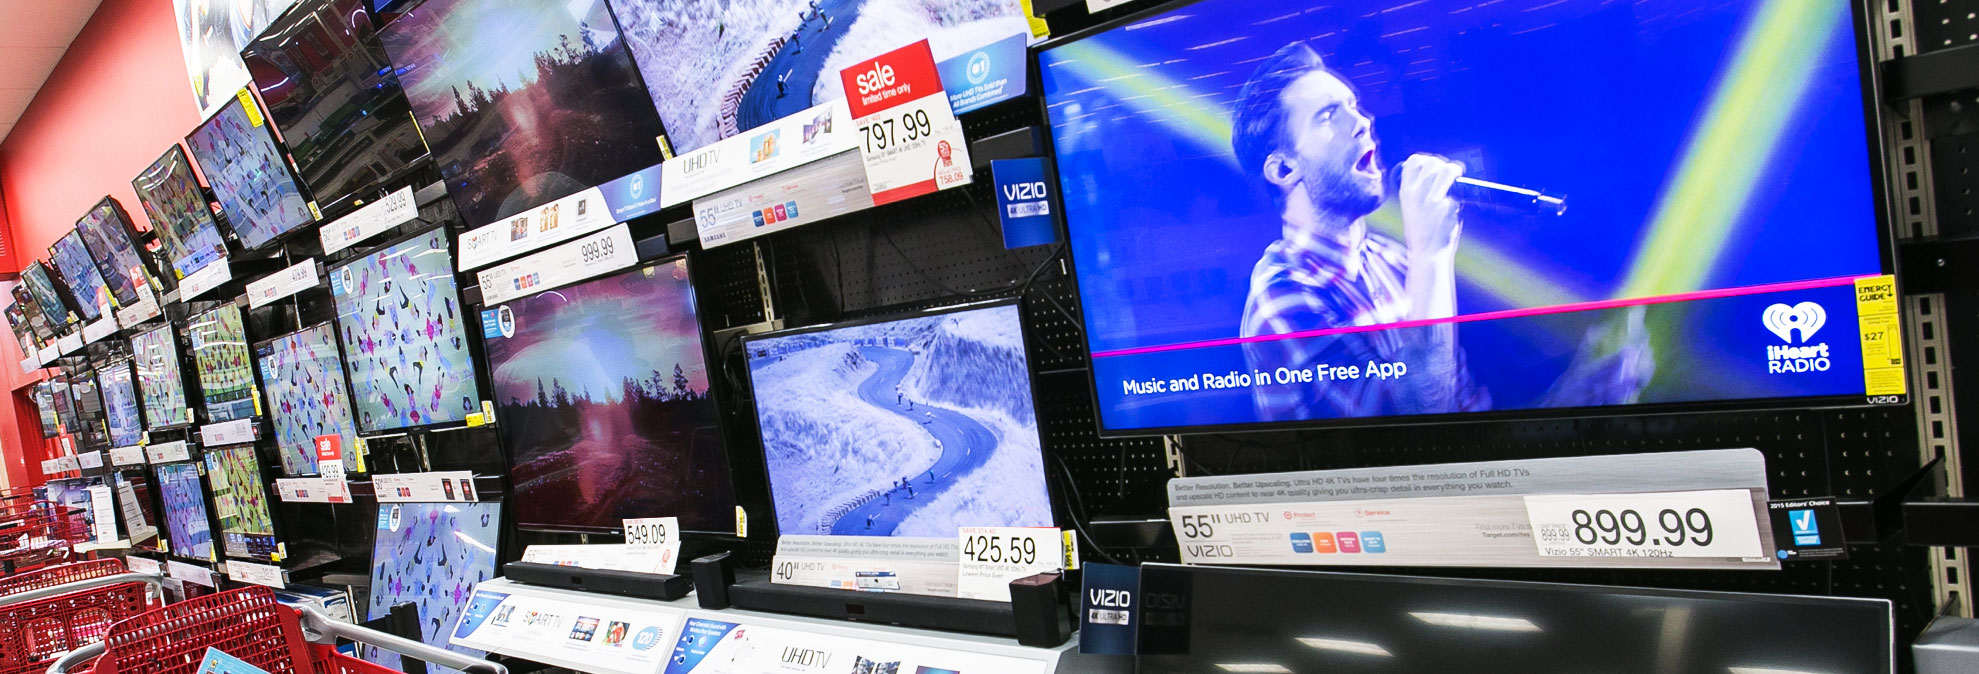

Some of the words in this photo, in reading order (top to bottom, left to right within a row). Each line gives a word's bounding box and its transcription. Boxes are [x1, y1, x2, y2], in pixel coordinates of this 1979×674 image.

[856, 61, 895, 94] sale
[862, 91, 882, 106] limited
[882, 88, 897, 99] time
[897, 82, 911, 94] only
[859, 109, 931, 153] 797.99
[683, 152, 707, 174] UHD
[708, 147, 721, 165] TV
[1004, 182, 1046, 201] VIZIO
[700, 208, 719, 228] 55"
[720, 202, 734, 212] UHD
[704, 232, 726, 242] SAMSUNG
[581, 236, 614, 263] 999.99
[482, 273, 493, 290] 55"
[1858, 285, 1891, 294] ENERGY
[1864, 332, 1884, 341] $27
[1767, 343, 1829, 360] iHeart
[1768, 358, 1830, 374] RADIO
[1123, 380, 1166, 395] Music
[1169, 375, 1200, 391] and
[1203, 372, 1251, 389] Radio
[1254, 369, 1271, 386] in
[1275, 366, 1313, 384] One
[1316, 364, 1360, 381] Free
[1365, 360, 1407, 380] App
[1867, 396, 1898, 404] VIZIO
[1195, 483, 1231, 491] Resolution,
[1389, 474, 1409, 482] times
[1427, 472, 1467, 480] resolution
[1470, 471, 1478, 479] of
[1480, 470, 1495, 478] Full
[1513, 468, 1530, 476] TVs
[1189, 493, 1212, 501] upscale
[1226, 491, 1250, 499] content
[1288, 488, 1310, 497] quality
[1312, 487, 1334, 496] giving
[1336, 488, 1349, 496] you
[1350, 485, 1388, 495] ultra-crisp
[1391, 484, 1412, 492] detail
[1423, 482, 1466, 492] everything
[1468, 483, 1483, 491] you
[1485, 480, 1513, 489] watch.
[627, 524, 666, 544] 549.09
[1182, 513, 1221, 538] 55"
[1225, 513, 1251, 524] UHD
[1254, 512, 1270, 523] TV
[1541, 528, 1570, 542] 899.99
[1572, 508, 1713, 547] 899.99
[964, 536, 1036, 564] 425.59
[1187, 545, 1234, 558] VIZIO
[1545, 547, 1567, 556] Vizio
[1569, 548, 1584, 556] 55"
[1588, 548, 1622, 556] SMART
[1642, 550, 1674, 558] 120Hz
[776, 562, 799, 580] 40"
[801, 562, 816, 571] UHD
[816, 563, 825, 571] TV
[1090, 588, 1130, 608] VIZIO
[1091, 612, 1099, 620] 4K
[781, 646, 814, 667] UHD
[816, 650, 832, 669] TV
